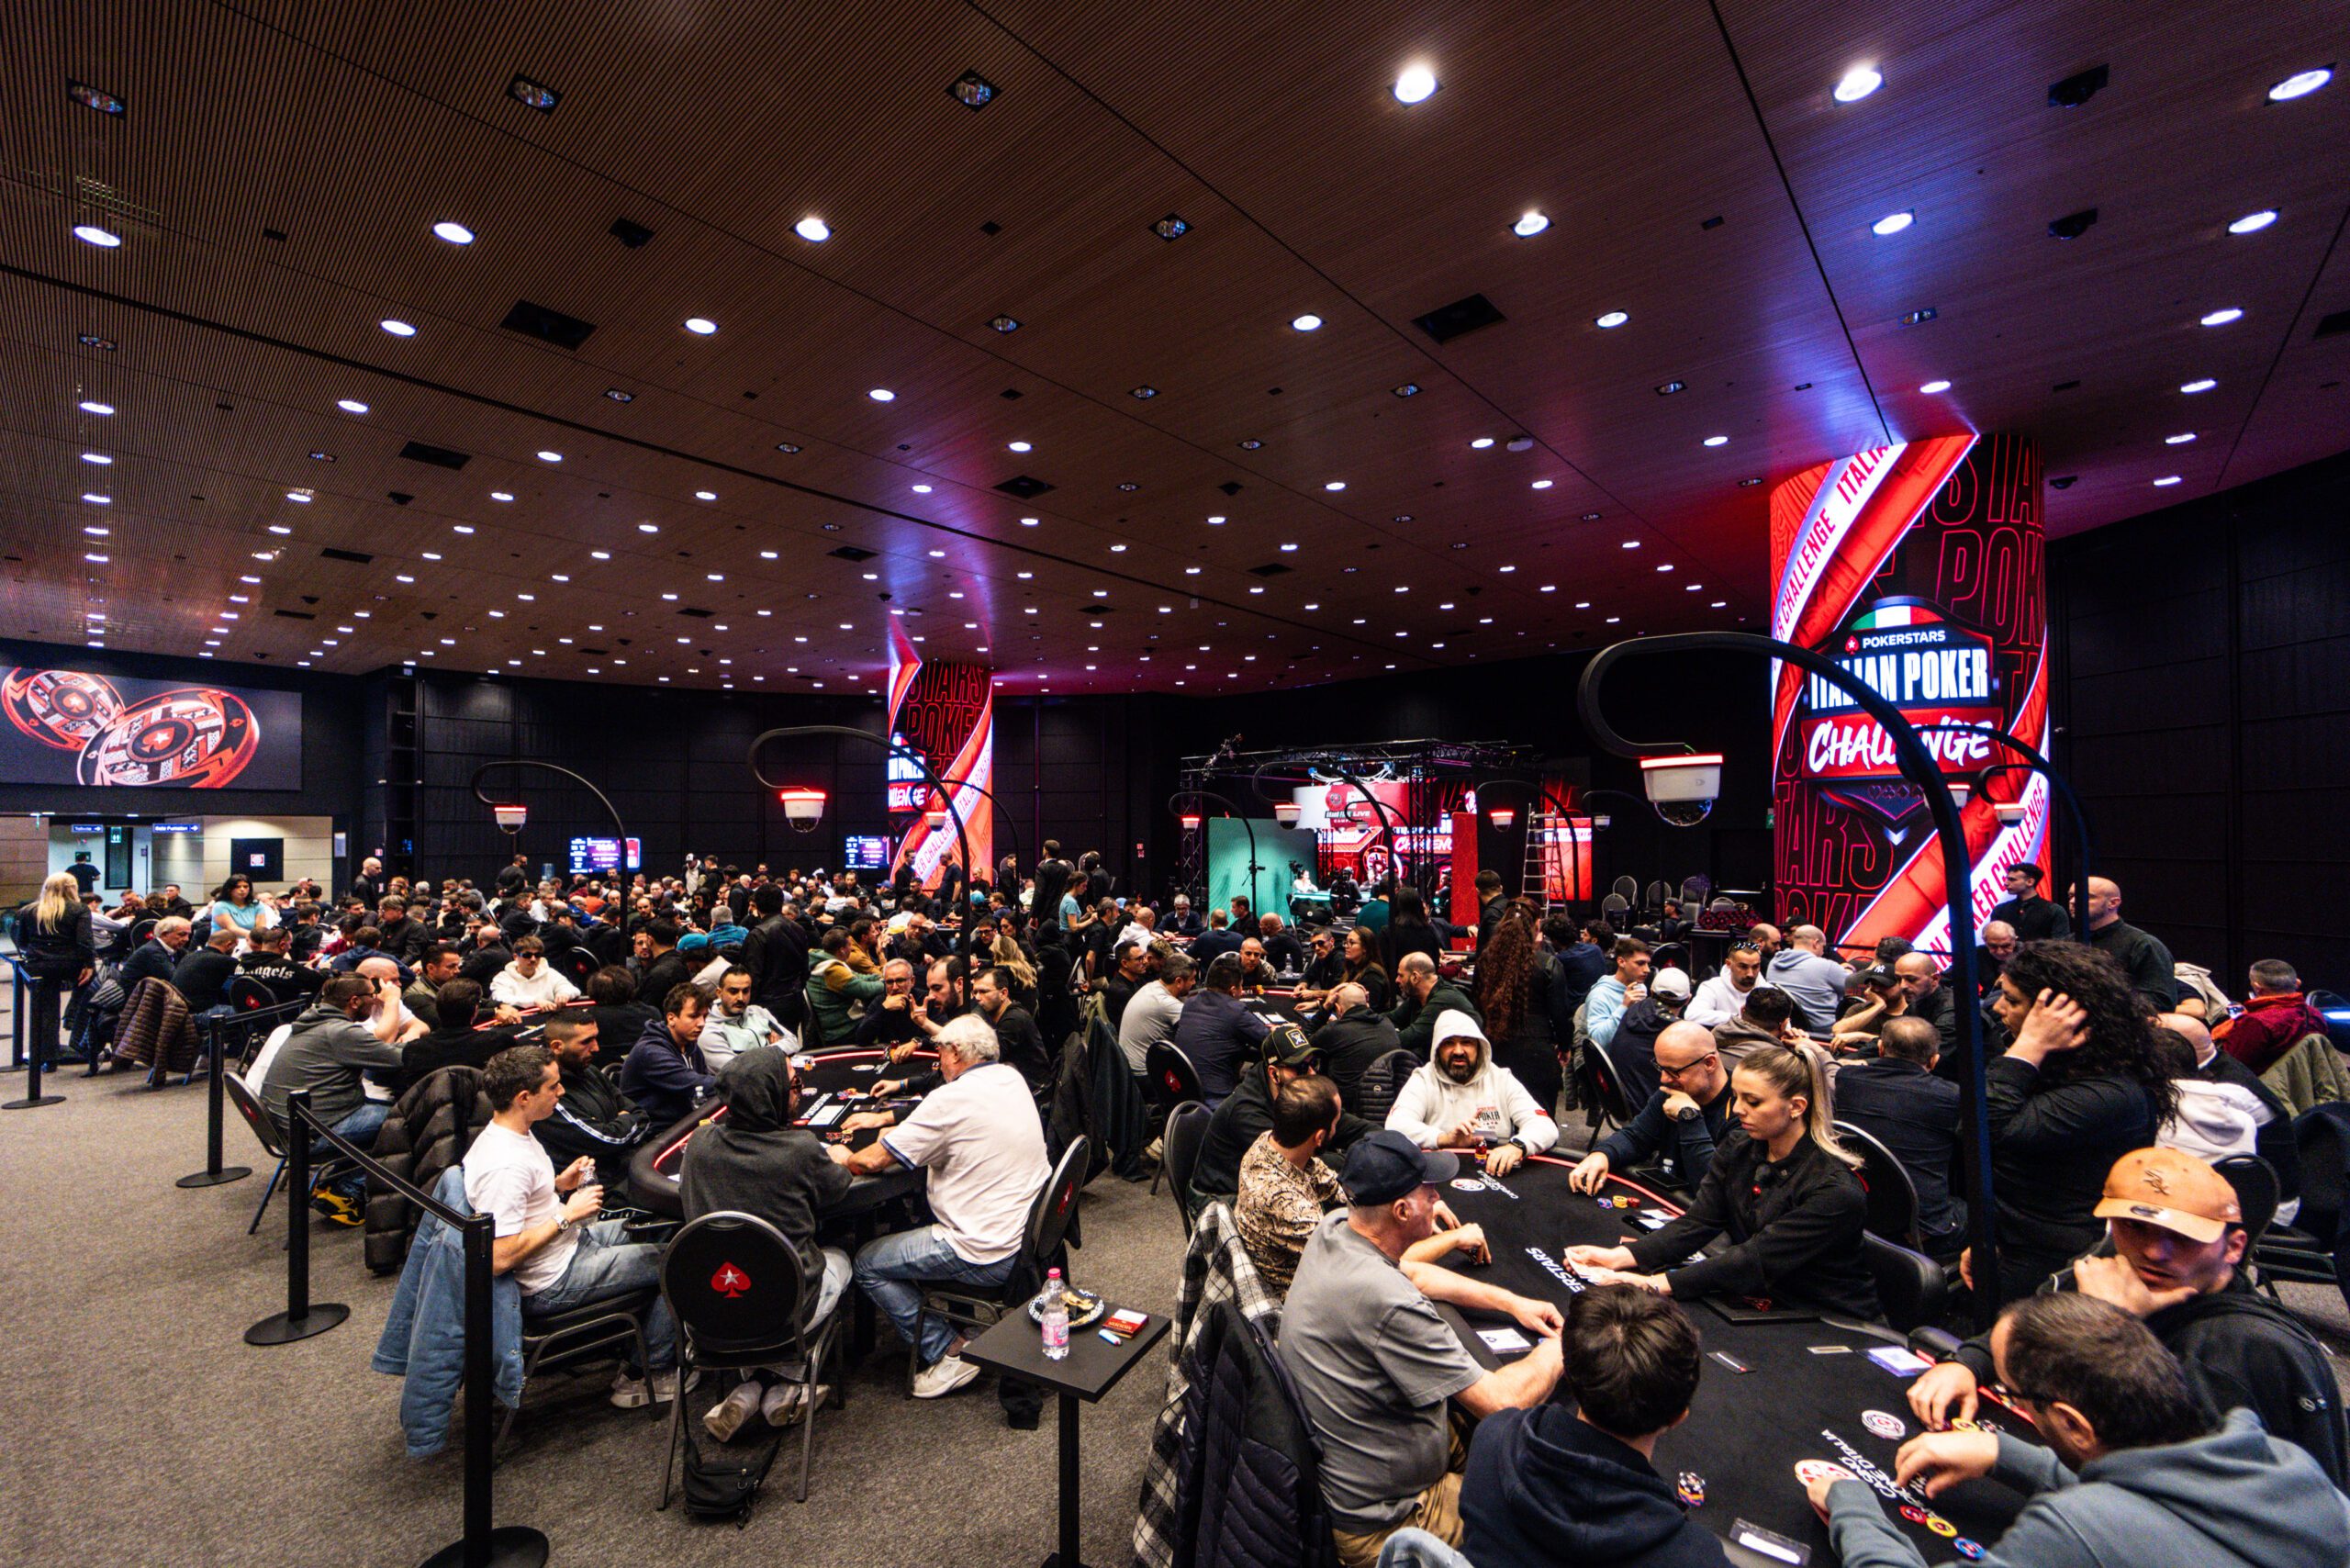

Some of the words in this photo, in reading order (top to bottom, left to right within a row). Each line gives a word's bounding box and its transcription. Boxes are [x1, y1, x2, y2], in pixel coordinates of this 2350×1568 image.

[1780, 508, 1836, 624] CHALLENGE
[1863, 630, 1946, 649] POKERSTARS
[1903, 648, 1988, 701] POKER
[1808, 715, 1994, 773] CHALLNGE
[924, 817, 957, 866] CHALLENG
[1478, 1110, 1501, 1121] POKER
[1525, 1247, 1586, 1293] ERSTARS
